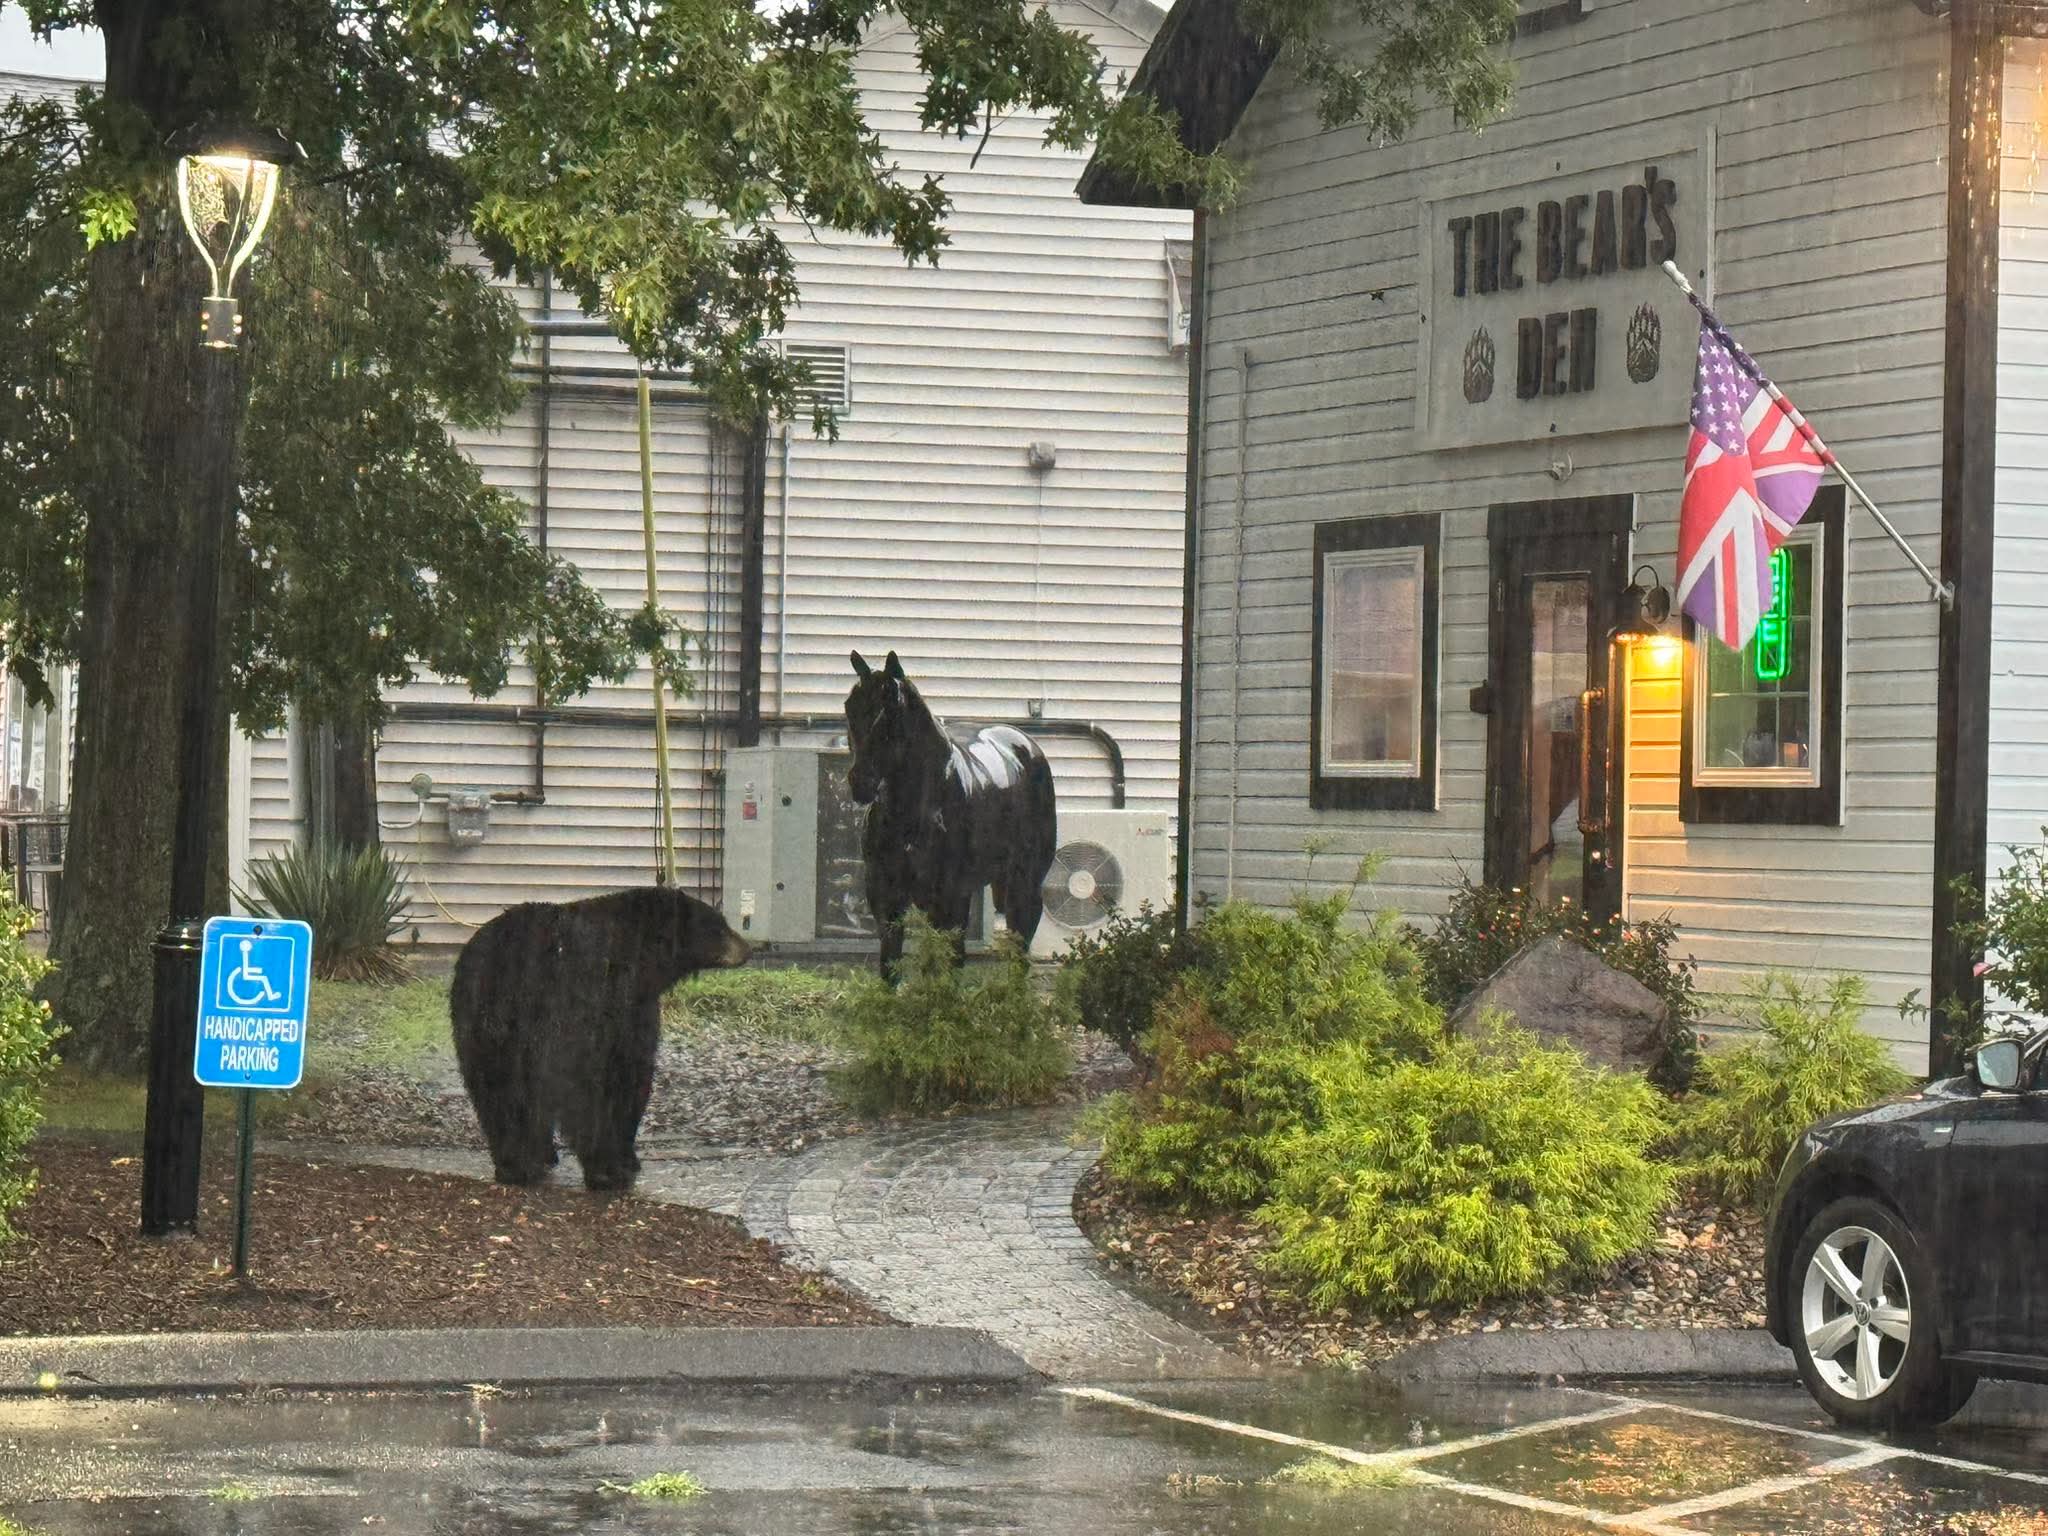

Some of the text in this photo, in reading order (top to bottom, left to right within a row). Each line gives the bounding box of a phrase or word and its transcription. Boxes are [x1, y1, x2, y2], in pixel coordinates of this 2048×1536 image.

[1448, 166, 1678, 298] THE BEAR'S
[1516, 307, 1597, 400] DEN
[205, 1015, 298, 1042] HANDICAPPED
[220, 1045, 279, 1072] PARKING
